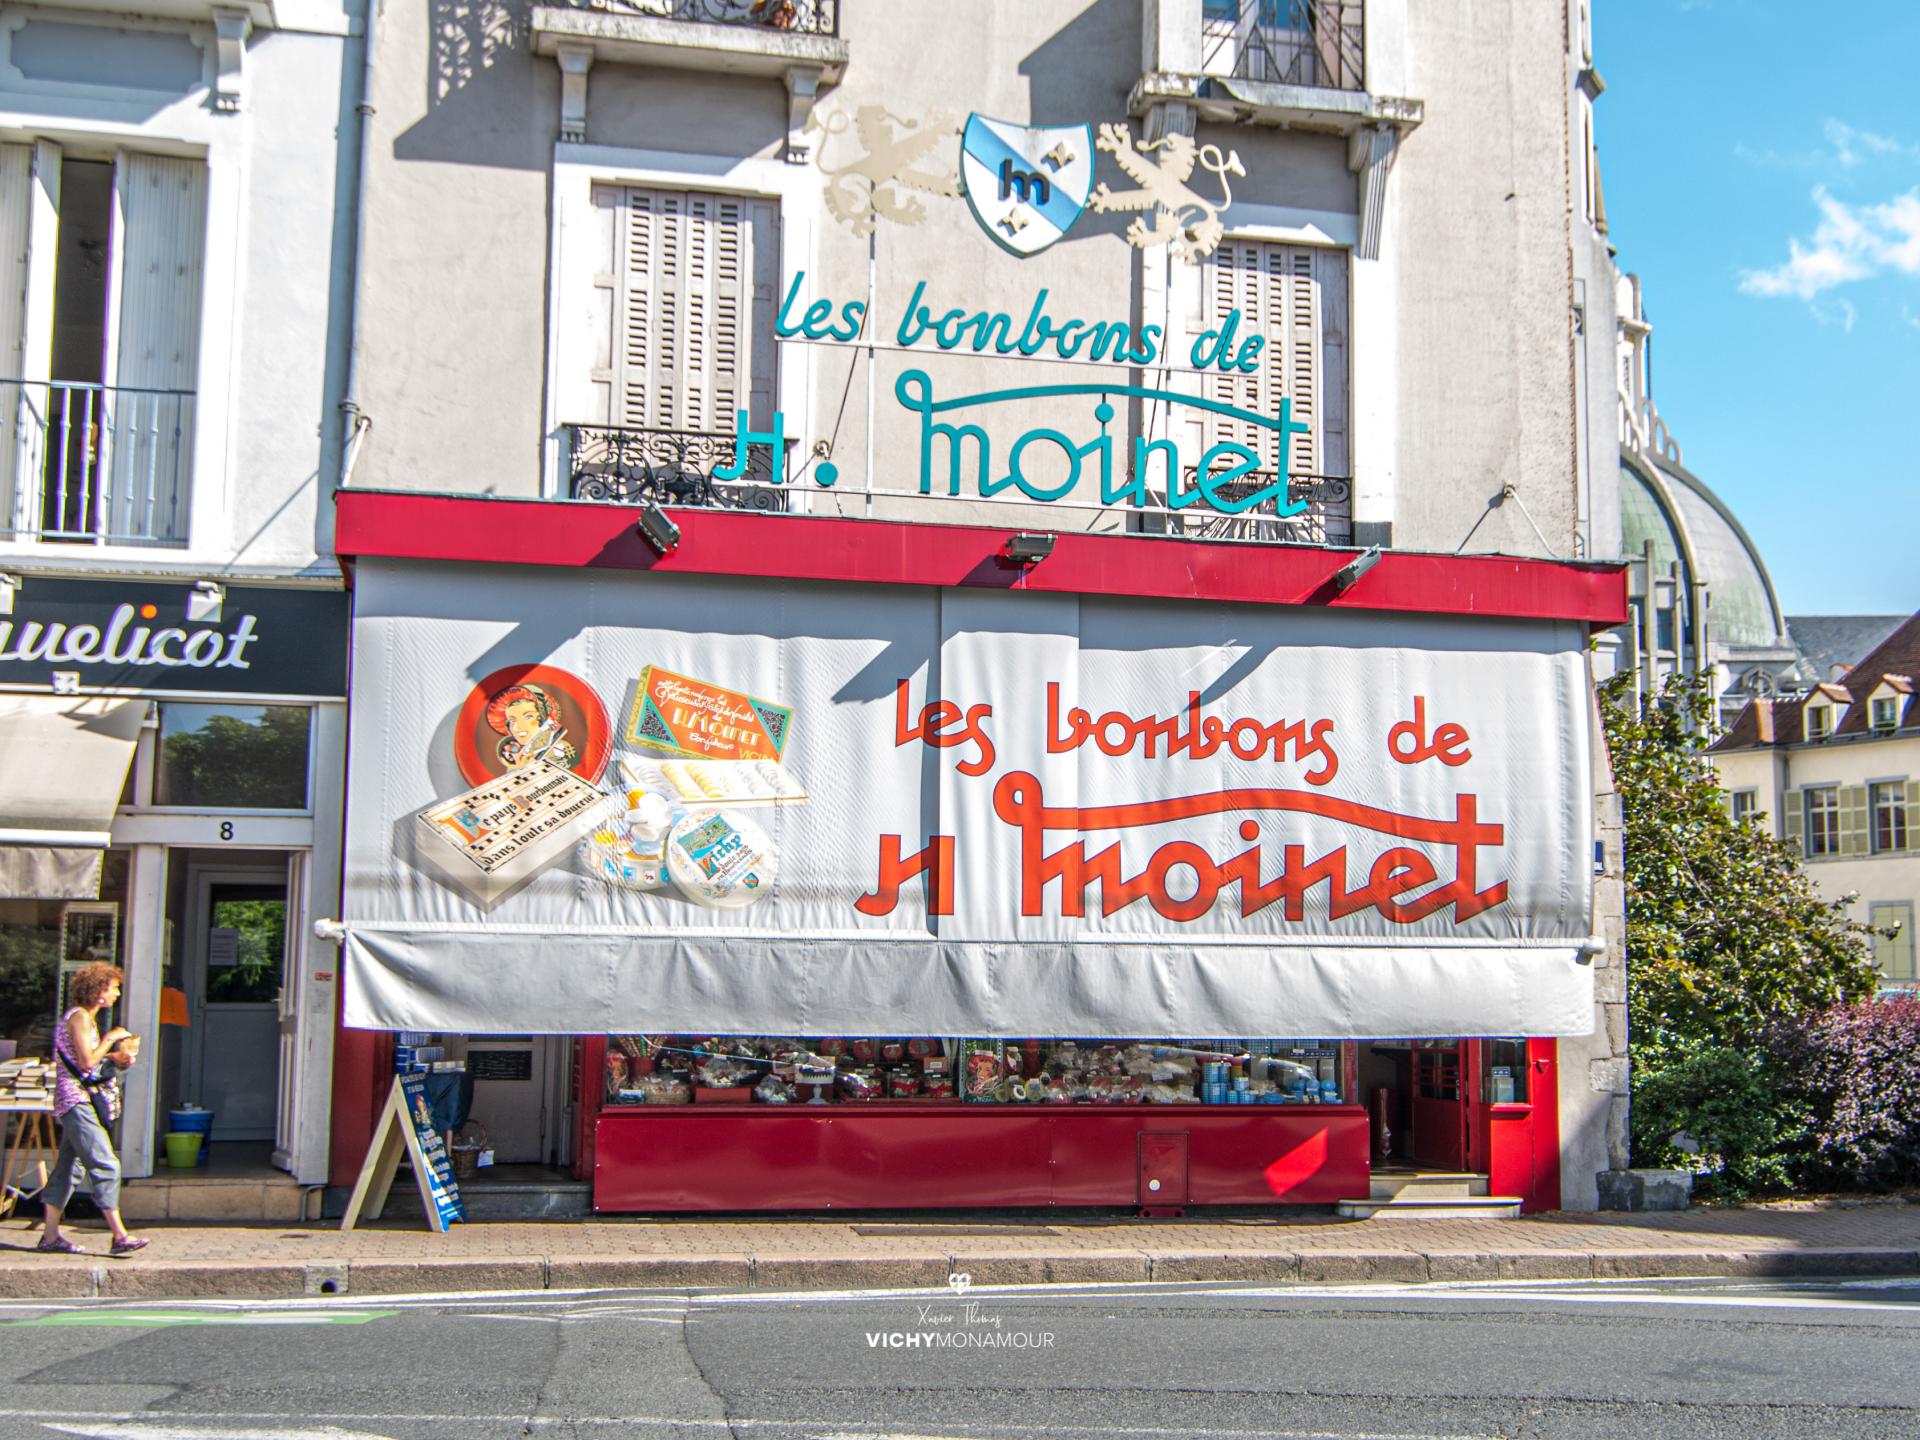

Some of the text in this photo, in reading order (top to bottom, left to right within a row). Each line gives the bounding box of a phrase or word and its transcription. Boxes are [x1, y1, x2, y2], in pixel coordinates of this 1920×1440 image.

[899, 281, 1161, 364] bonbons
[1191, 309, 1265, 372] de
[1046, 682, 1338, 786] bonbons
[1388, 696, 1473, 767] de
[220, 821, 234, 841] 8
[484, 844, 516, 866] dans
[544, 816, 560, 829] sa
[558, 792, 596, 819] douceur
[493, 803, 518, 825] pays
[511, 774, 570, 810] Bourbonnais
